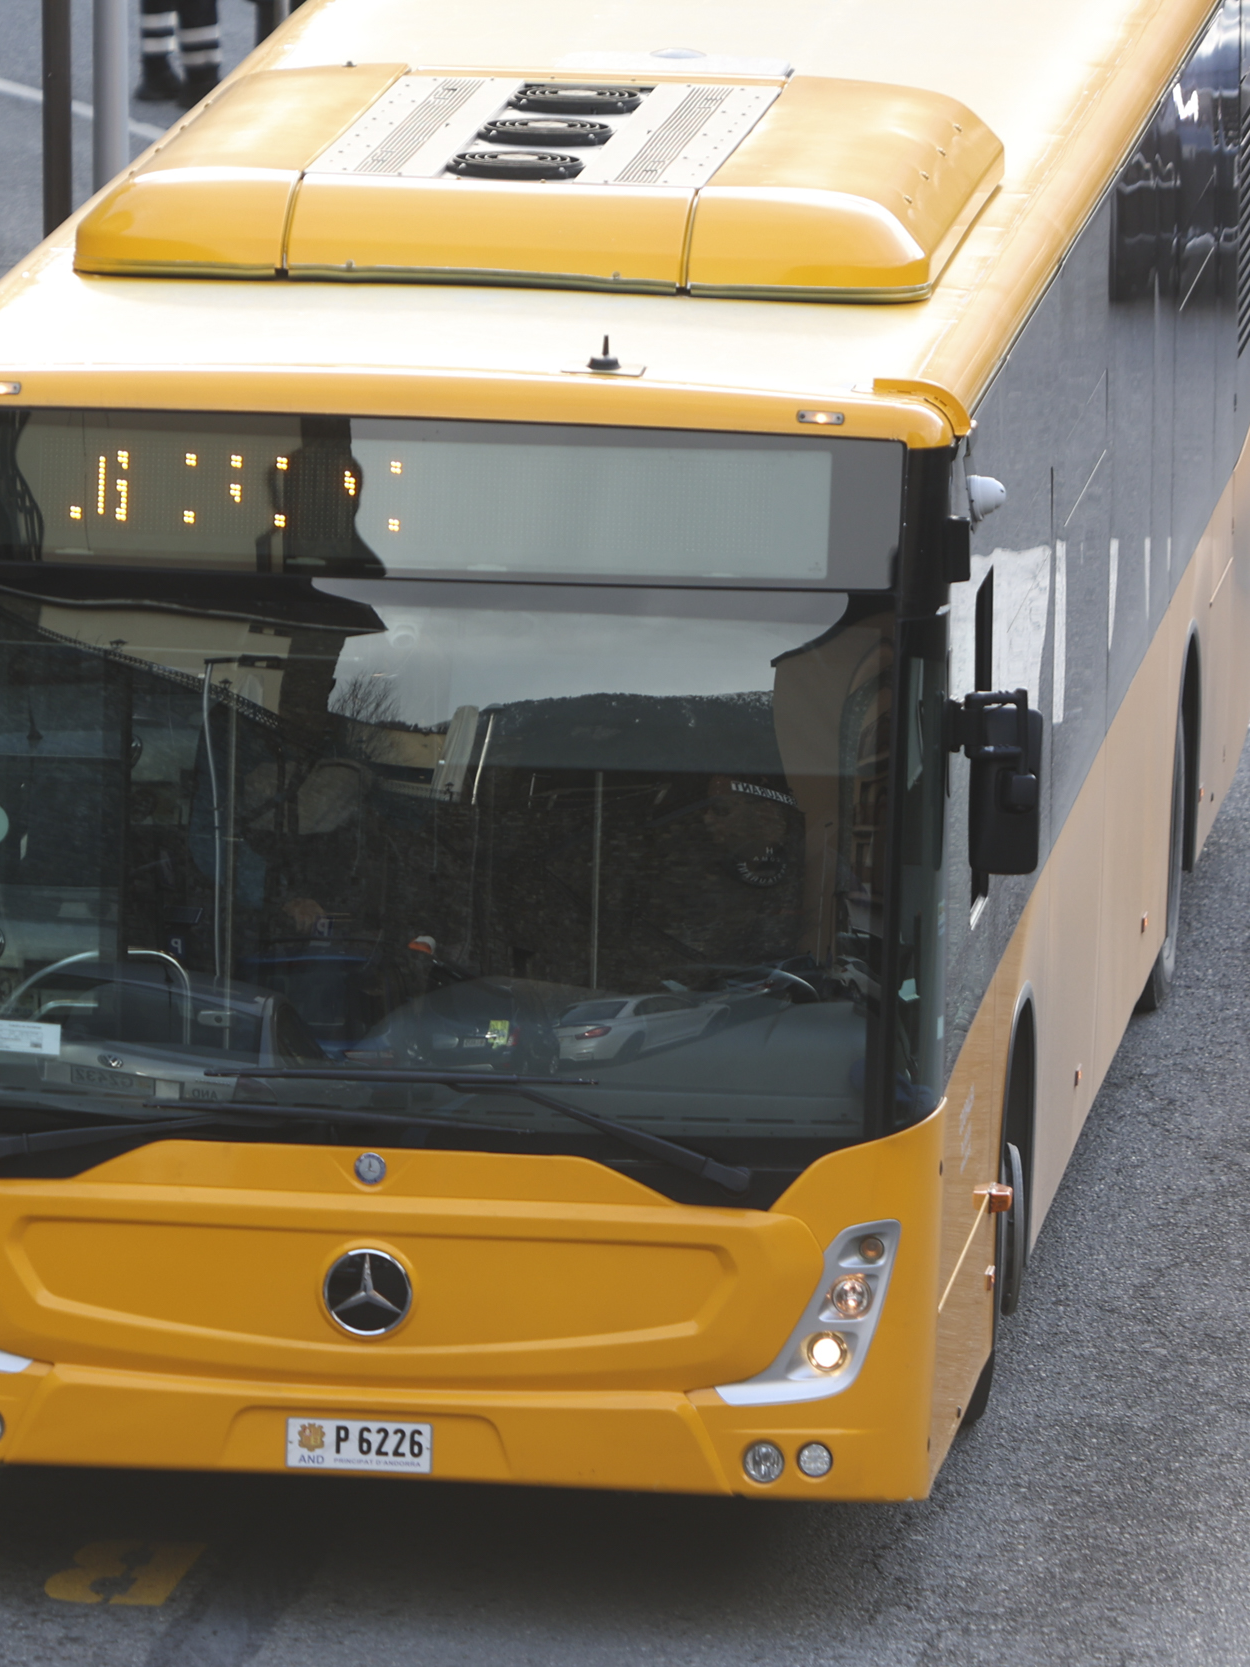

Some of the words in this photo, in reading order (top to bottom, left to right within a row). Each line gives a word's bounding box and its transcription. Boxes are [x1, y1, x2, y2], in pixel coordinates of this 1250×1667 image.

[335, 1425, 350, 1454] P
[358, 1426, 423, 1458] 6226
[298, 1454, 325, 1464] AND
[333, 1457, 373, 1465] PRINCIPAT
[375, 1458, 421, 1467] D'ANDORRA
